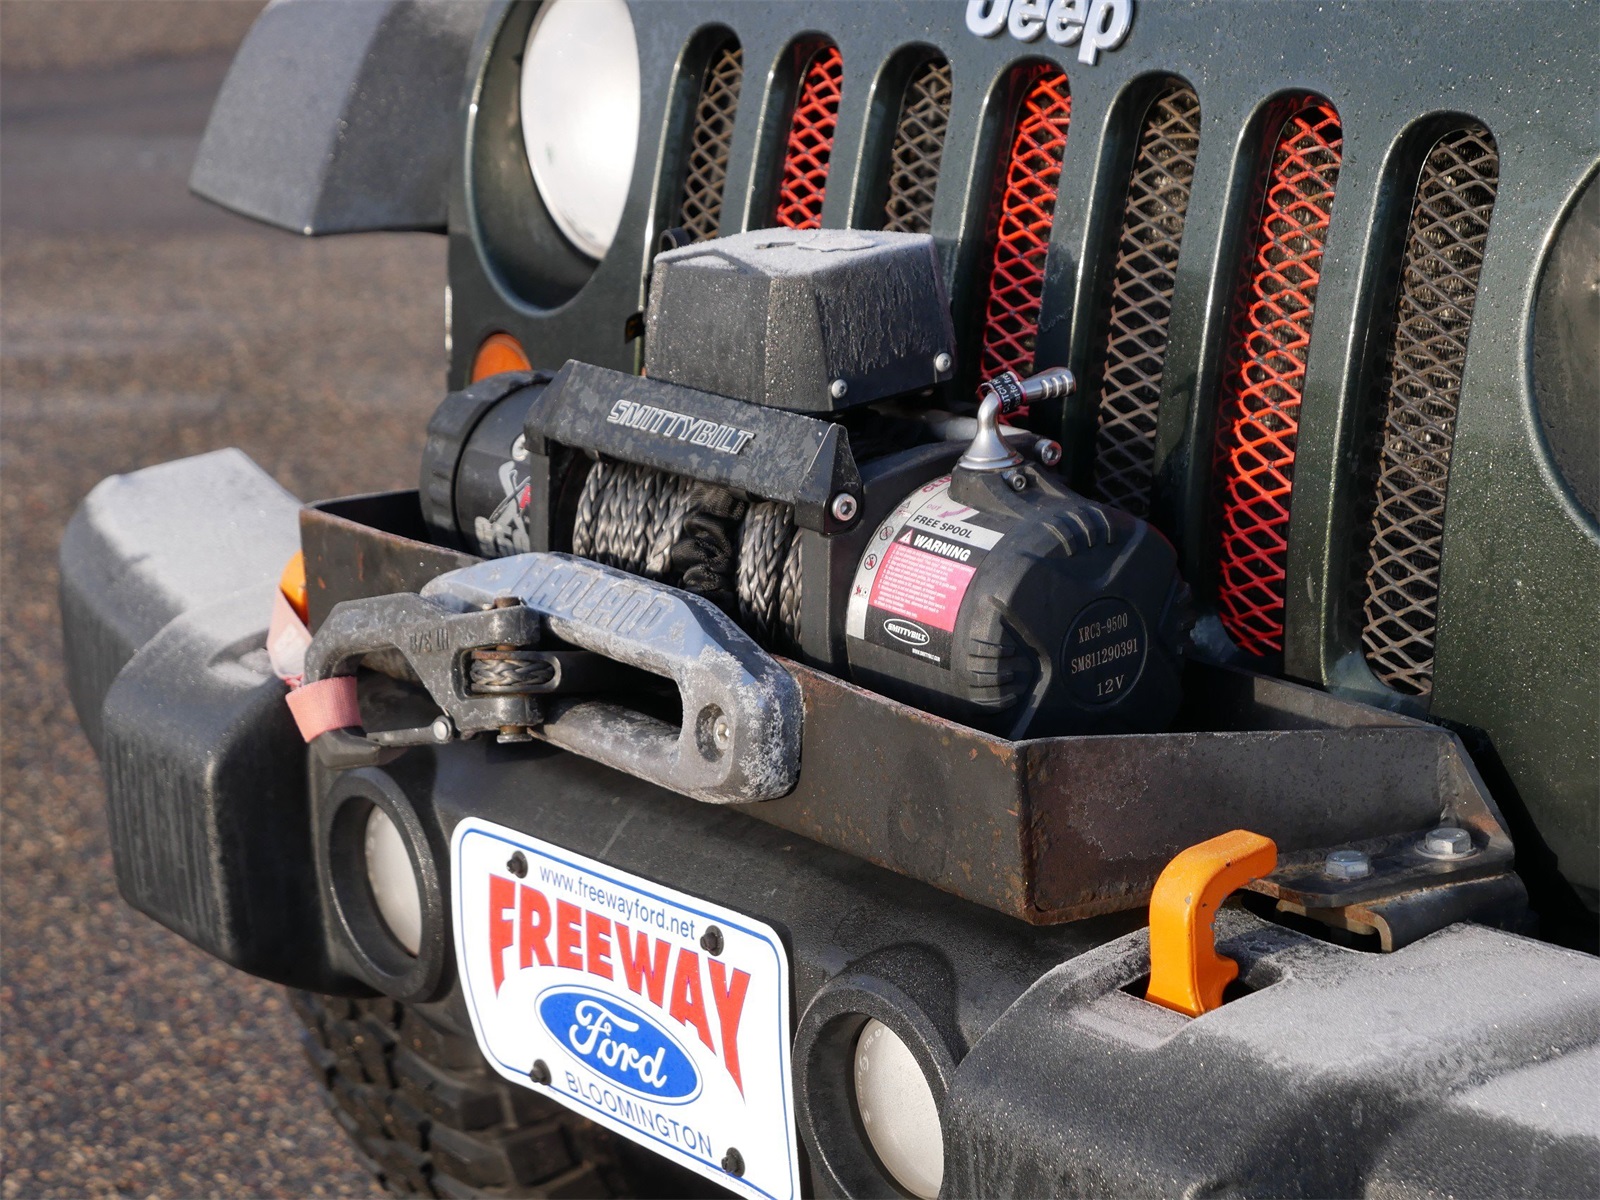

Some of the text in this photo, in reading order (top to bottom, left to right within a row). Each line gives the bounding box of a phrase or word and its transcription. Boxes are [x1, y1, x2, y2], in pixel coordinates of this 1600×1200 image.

[607, 399, 755, 455] SMITTYBILT
[913, 514, 973, 539] FREE SPOOL
[913, 534, 972, 562] WARNING
[887, 623, 927, 642] SMITTYBILT
[1078, 612, 1128, 643] XRC3-9500
[1071, 638, 1138, 674] SM811290391
[1096, 674, 1125, 697] 12V
[540, 865, 696, 941] www.freewayford.net
[489, 873, 752, 1105] FREEWAY
[569, 999, 668, 1089] Ford
[565, 1070, 714, 1158] BLOOMINGTON
